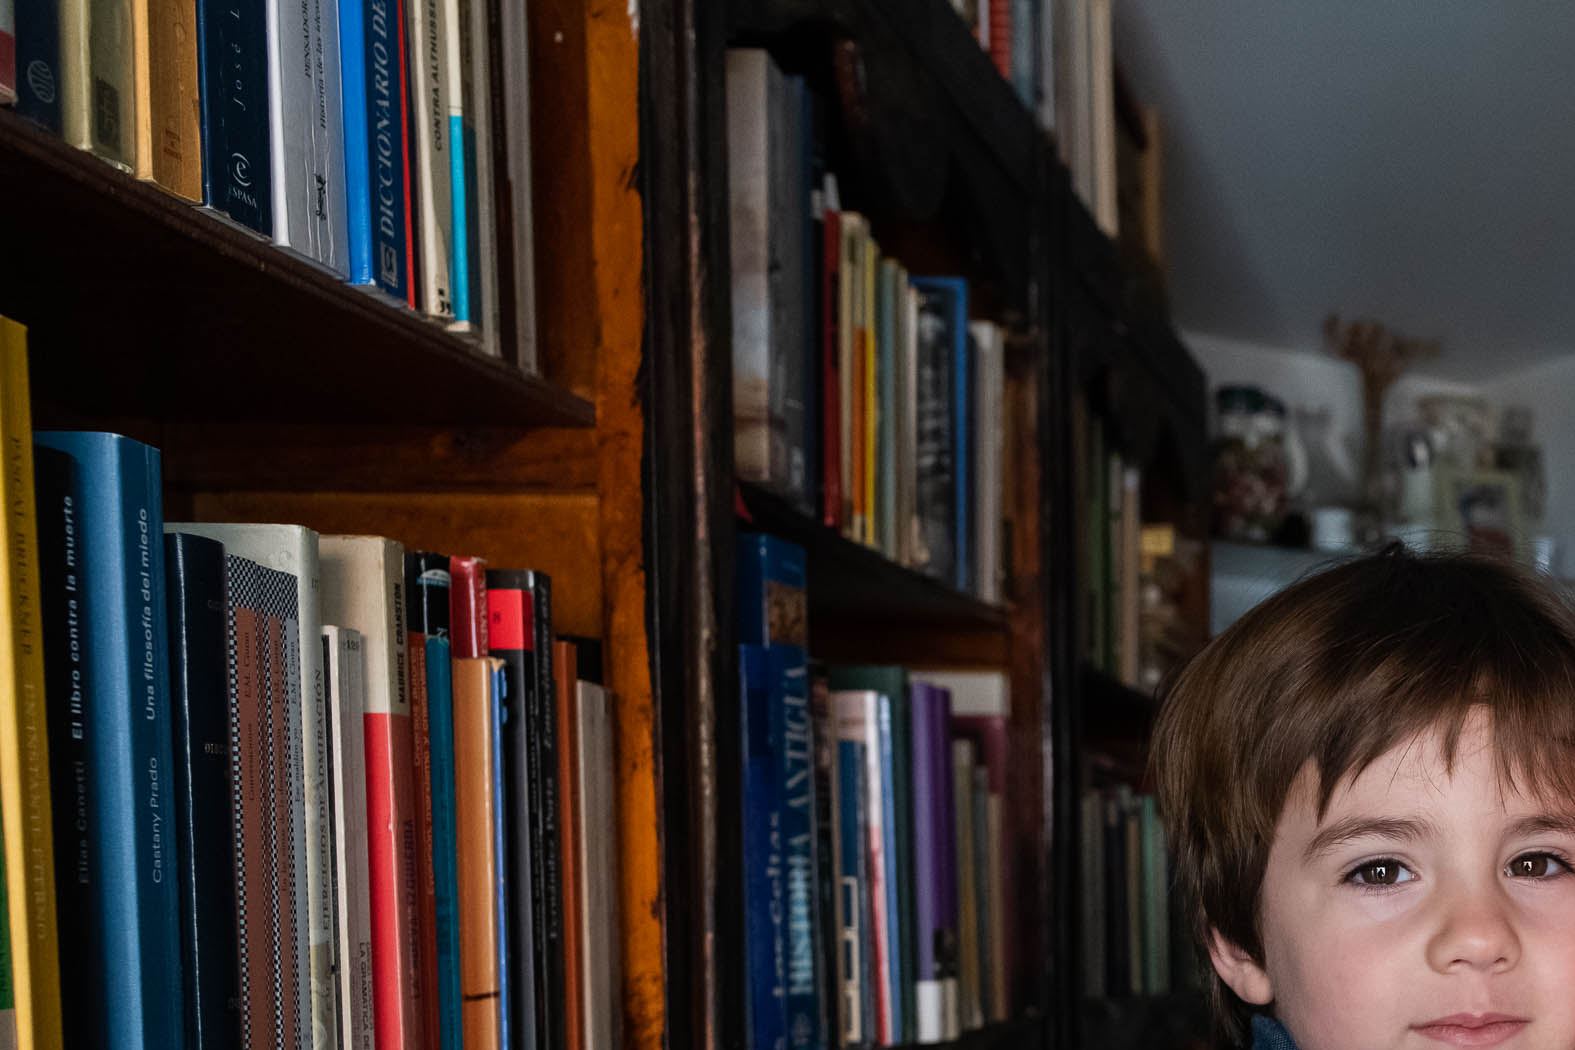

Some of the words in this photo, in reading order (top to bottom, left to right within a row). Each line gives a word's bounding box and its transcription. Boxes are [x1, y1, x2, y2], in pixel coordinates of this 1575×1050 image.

[373, 41, 396, 239] DICCIONARIO
[431, 87, 443, 152] CONTRA
[62, 495, 76, 567] muerte
[137, 507, 152, 568] miedo
[64, 574, 79, 590] la
[139, 570, 153, 603] del
[392, 582, 405, 647] CRANSTON
[66, 598, 80, 663] contra
[141, 607, 157, 682] filosofía
[67, 669, 83, 714] libro
[144, 685, 157, 721] Una
[394, 651, 408, 704] MAURICE
[70, 721, 85, 741] El
[313, 668, 328, 791] ADMIRACIÓN
[782, 664, 814, 808] ANTIGUA
[75, 759, 89, 832] Canetti
[147, 756, 161, 808] Prado
[78, 838, 91, 886] Elias
[150, 814, 166, 884] Castany
[318, 823, 332, 931] EJERCICIOS
[787, 833, 815, 997] HISTORIA
[360, 943, 367, 958] LA
